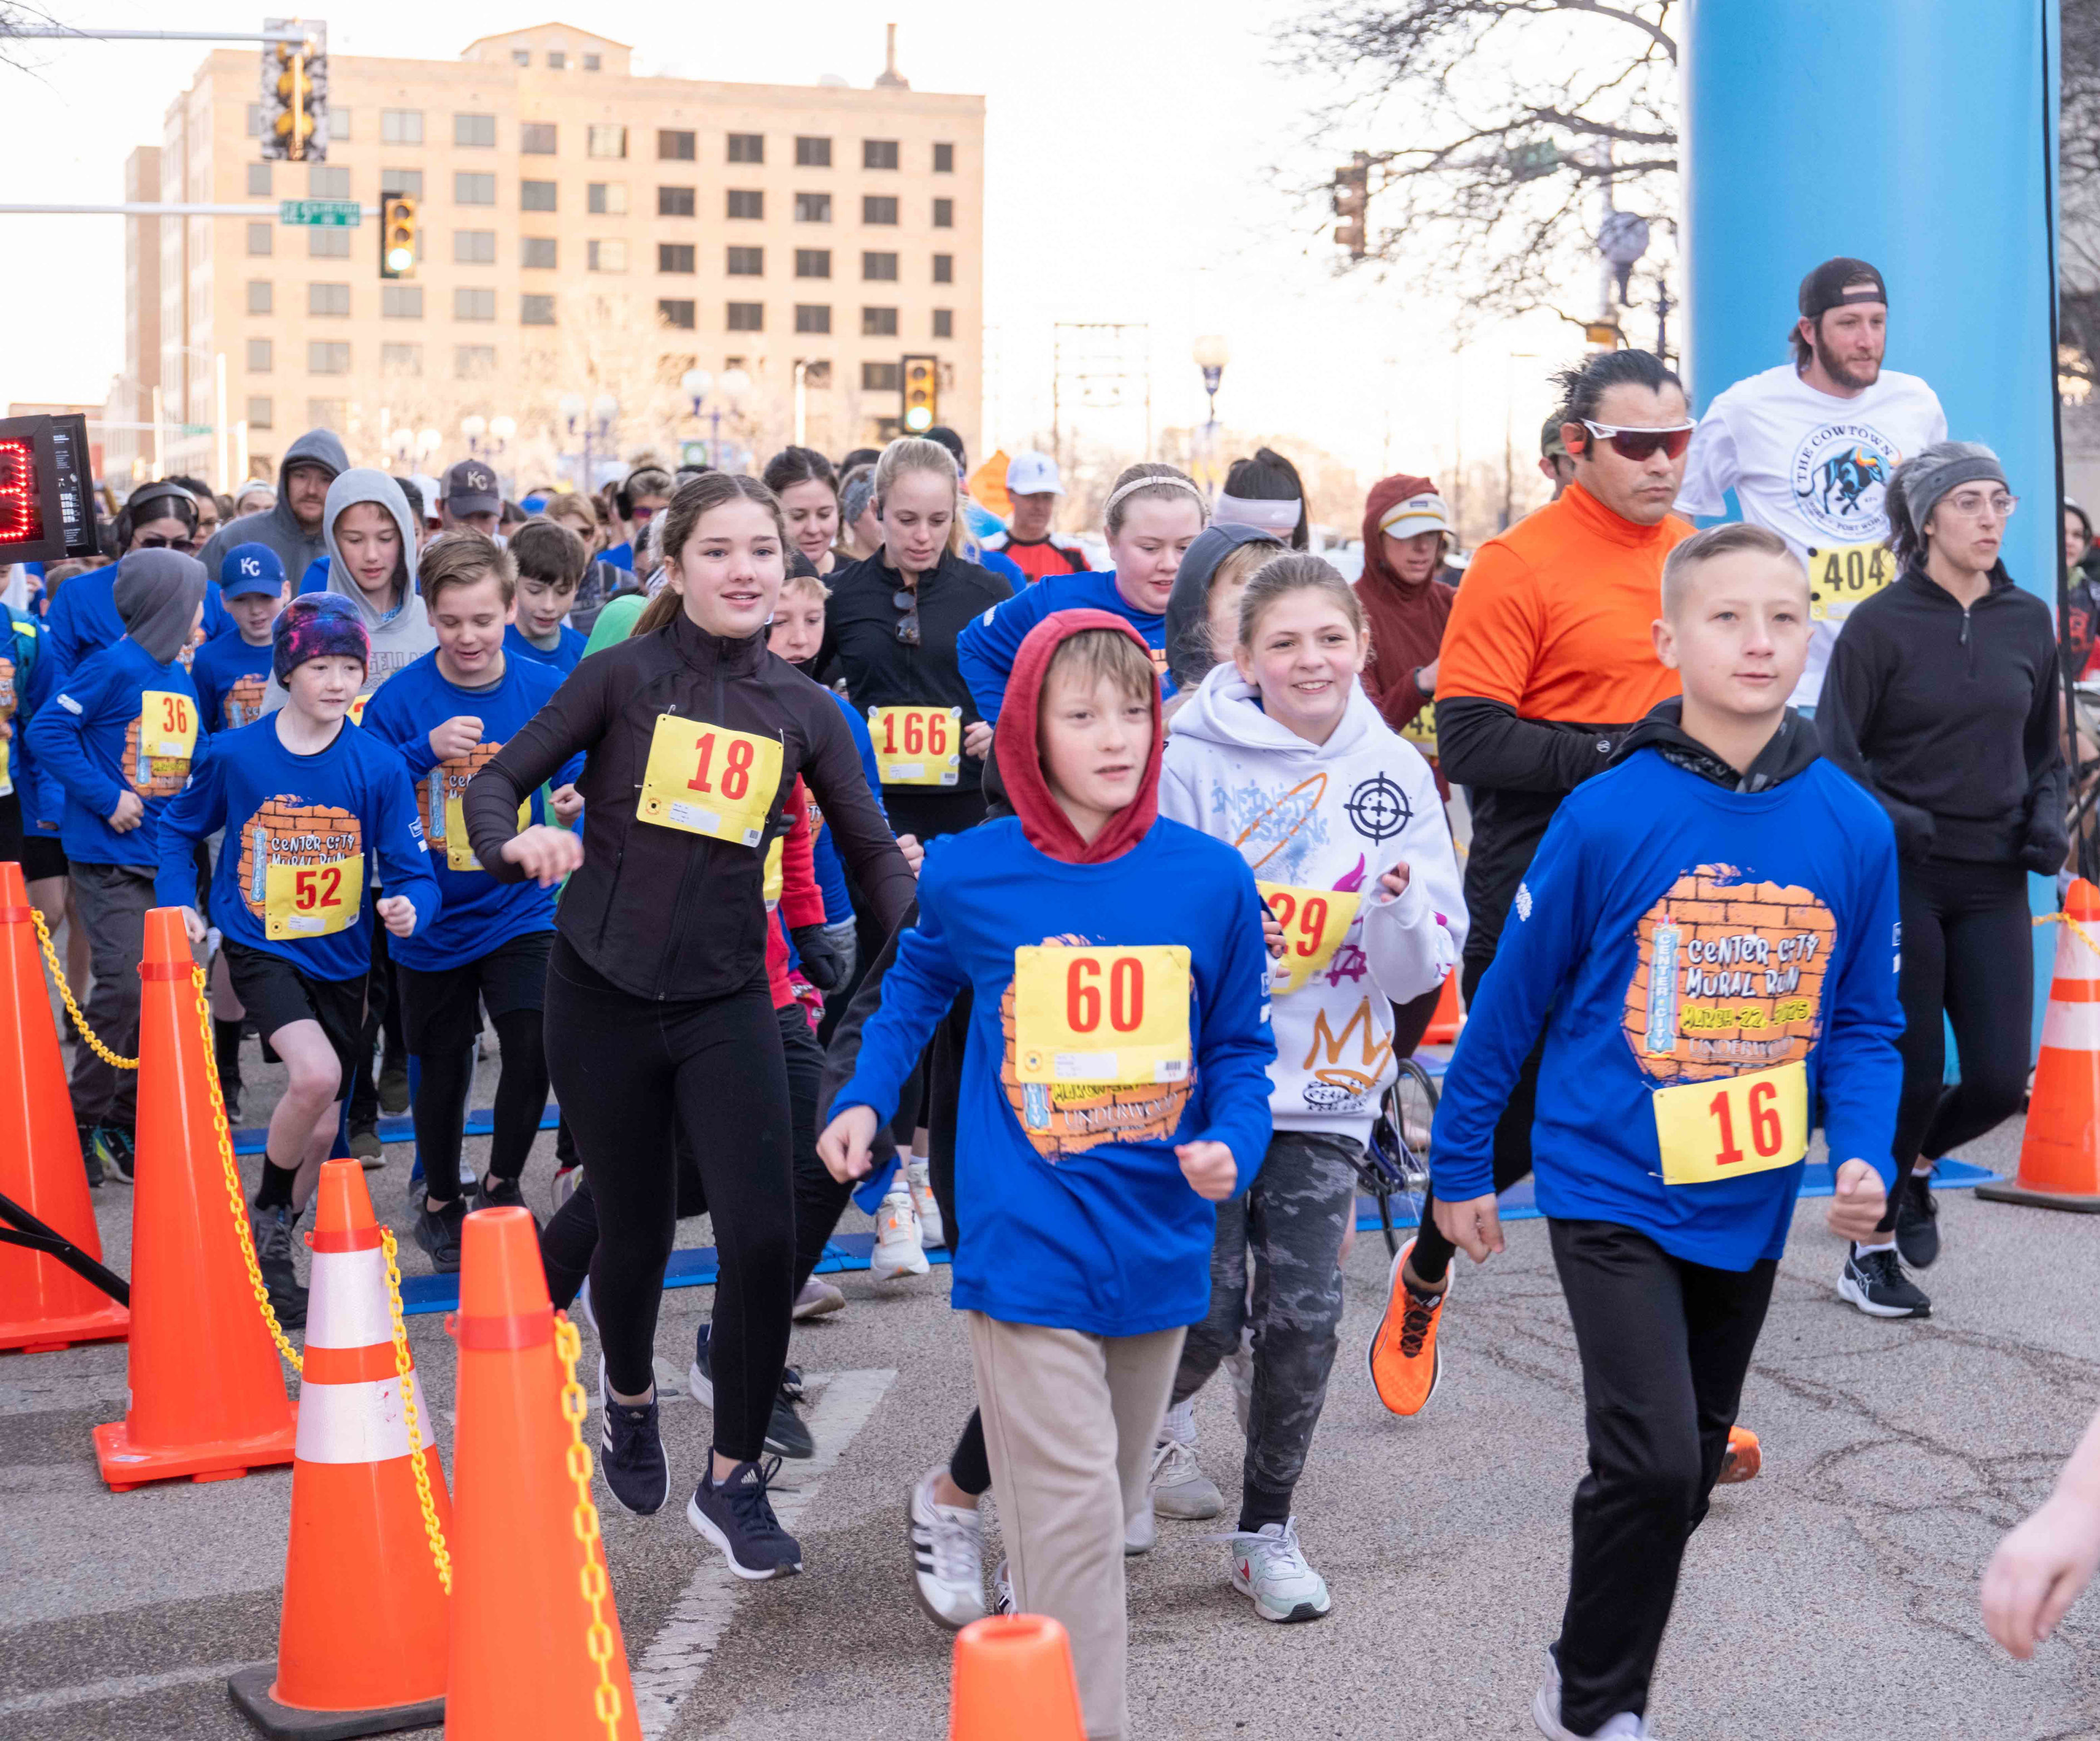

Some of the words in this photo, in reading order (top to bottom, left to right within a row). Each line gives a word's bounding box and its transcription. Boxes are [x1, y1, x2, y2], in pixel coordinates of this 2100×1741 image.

[1798, 447, 1813, 483] THE
[1812, 425, 1893, 455] COWTOWN
[467, 470, 488, 491] KC
[240, 557, 261, 577] KC
[1824, 548, 1885, 591] 404
[163, 697, 187, 734] 36
[882, 712, 946, 756] 166
[687, 732, 754, 800] 18
[256, 832, 264, 870] CENTER
[255, 876, 264, 900] CITY
[296, 867, 342, 910] 52
[1268, 892, 1328, 957] 29
[1656, 934, 1672, 996] CENTER
[1685, 966, 1757, 998] MURAL
[1067, 957, 1145, 1033] 60
[1655, 1008, 1670, 1049] CITY
[1709, 1081, 1784, 1166] 16
